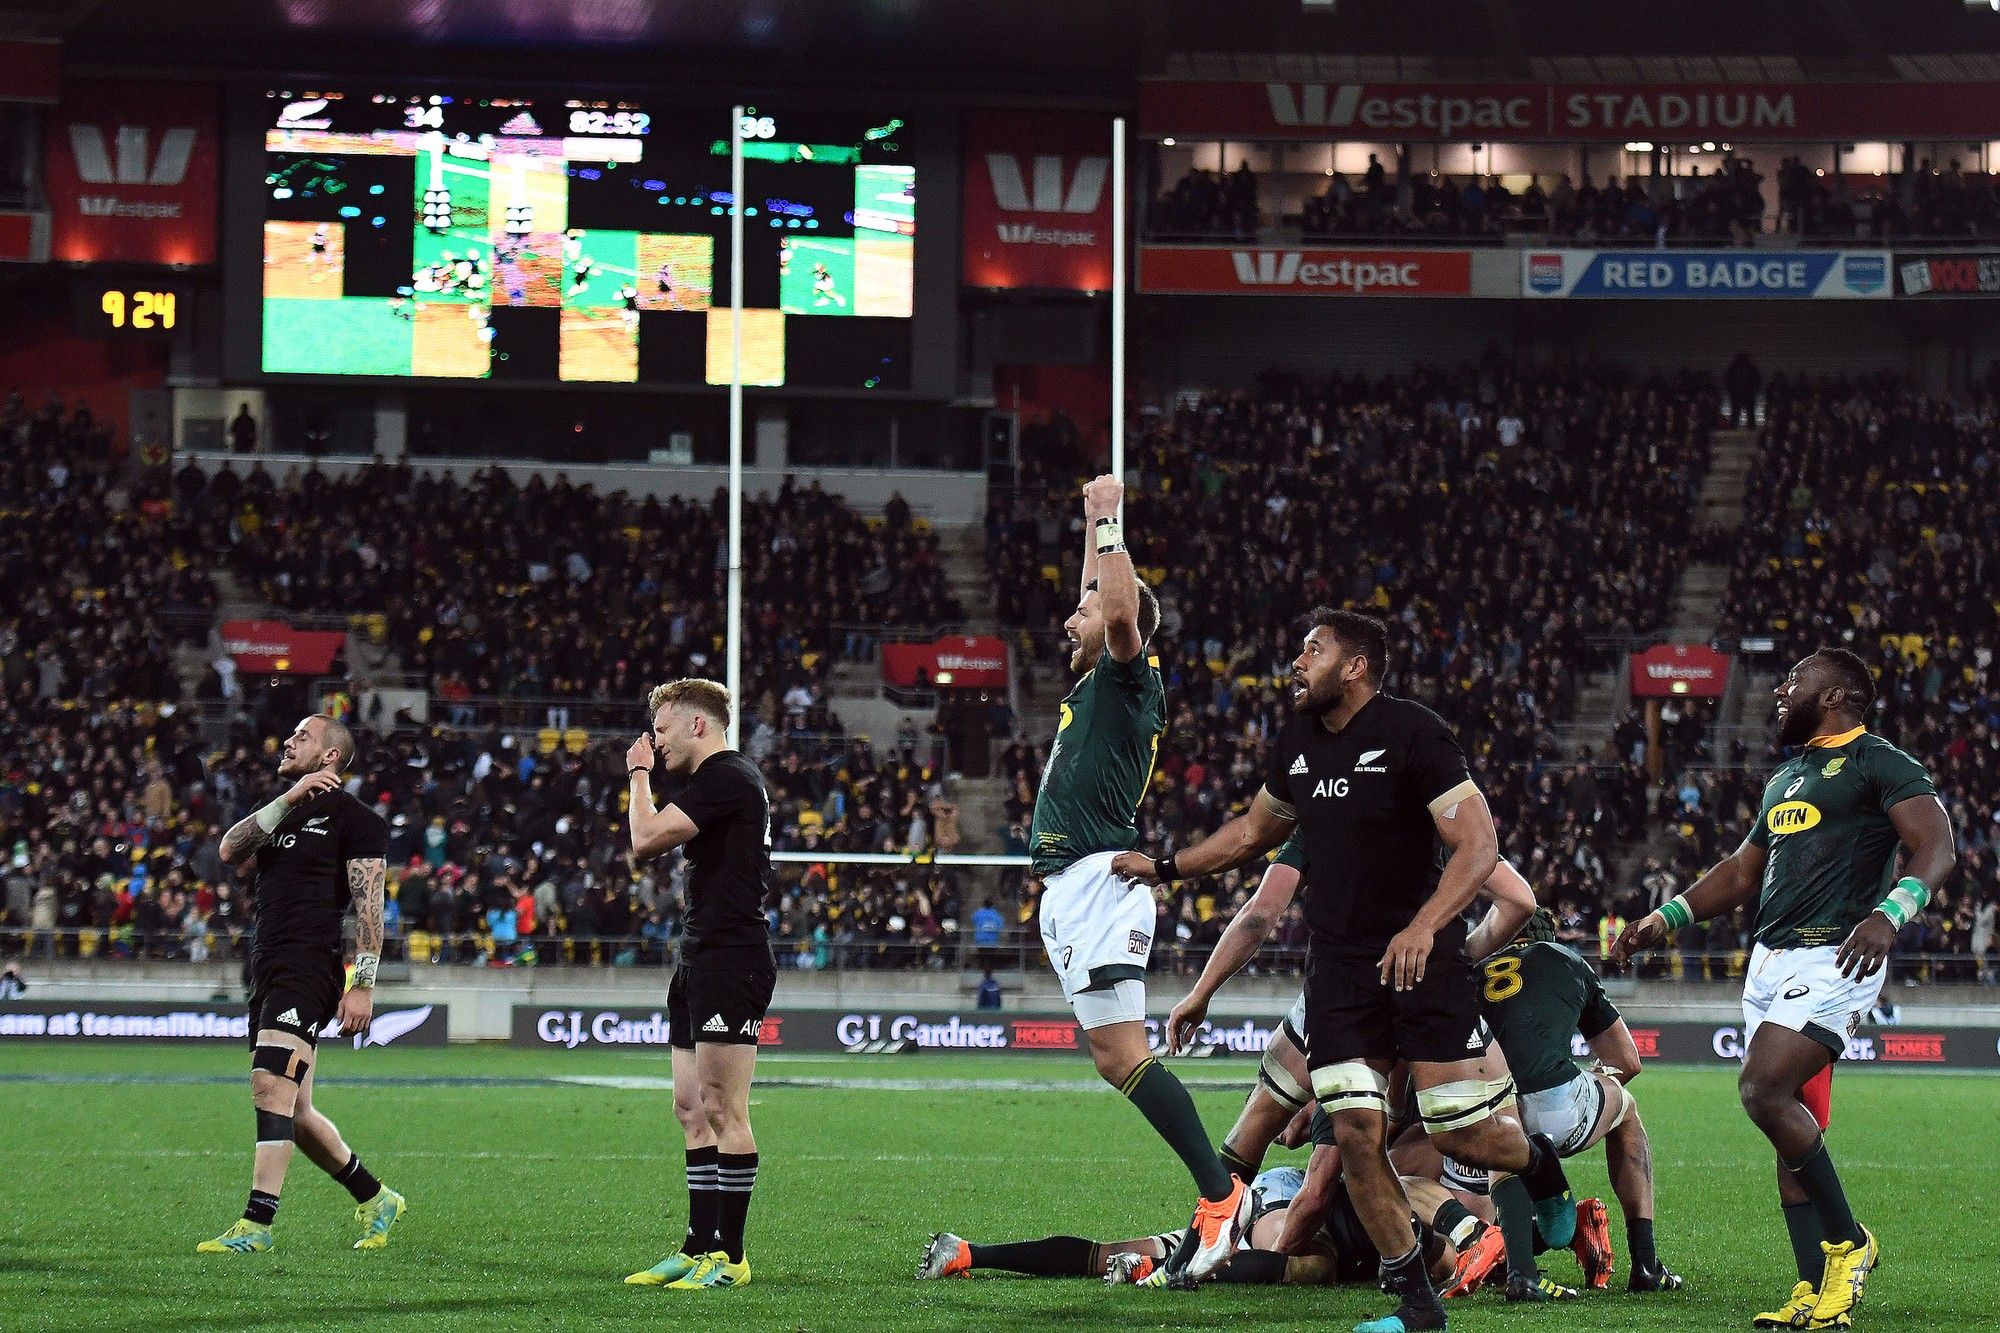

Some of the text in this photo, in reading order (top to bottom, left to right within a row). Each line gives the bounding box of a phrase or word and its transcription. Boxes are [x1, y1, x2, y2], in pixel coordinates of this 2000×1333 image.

[404, 106, 444, 128] 34
[1266, 84, 1796, 136] Westpac STADIUM
[740, 116, 776, 139] 36
[80, 197, 181, 219] Westpac
[997, 223, 1096, 248] Westpac
[1232, 252, 1420, 292] Westpac
[1603, 261, 1807, 289] RED BADGE
[132, 292, 175, 329] 24
[1312, 778, 1349, 798] AIG
[1773, 808, 1808, 828] MTN
[1484, 956, 1523, 1002] 8
[47, 1011, 80, 1036] at
[81, 1011, 249, 1037] teamallblac
[537, 1010, 589, 1049] G.J.
[1015, 1026, 1076, 1045] HOMES
[1883, 1040, 1943, 1058] HOMES
